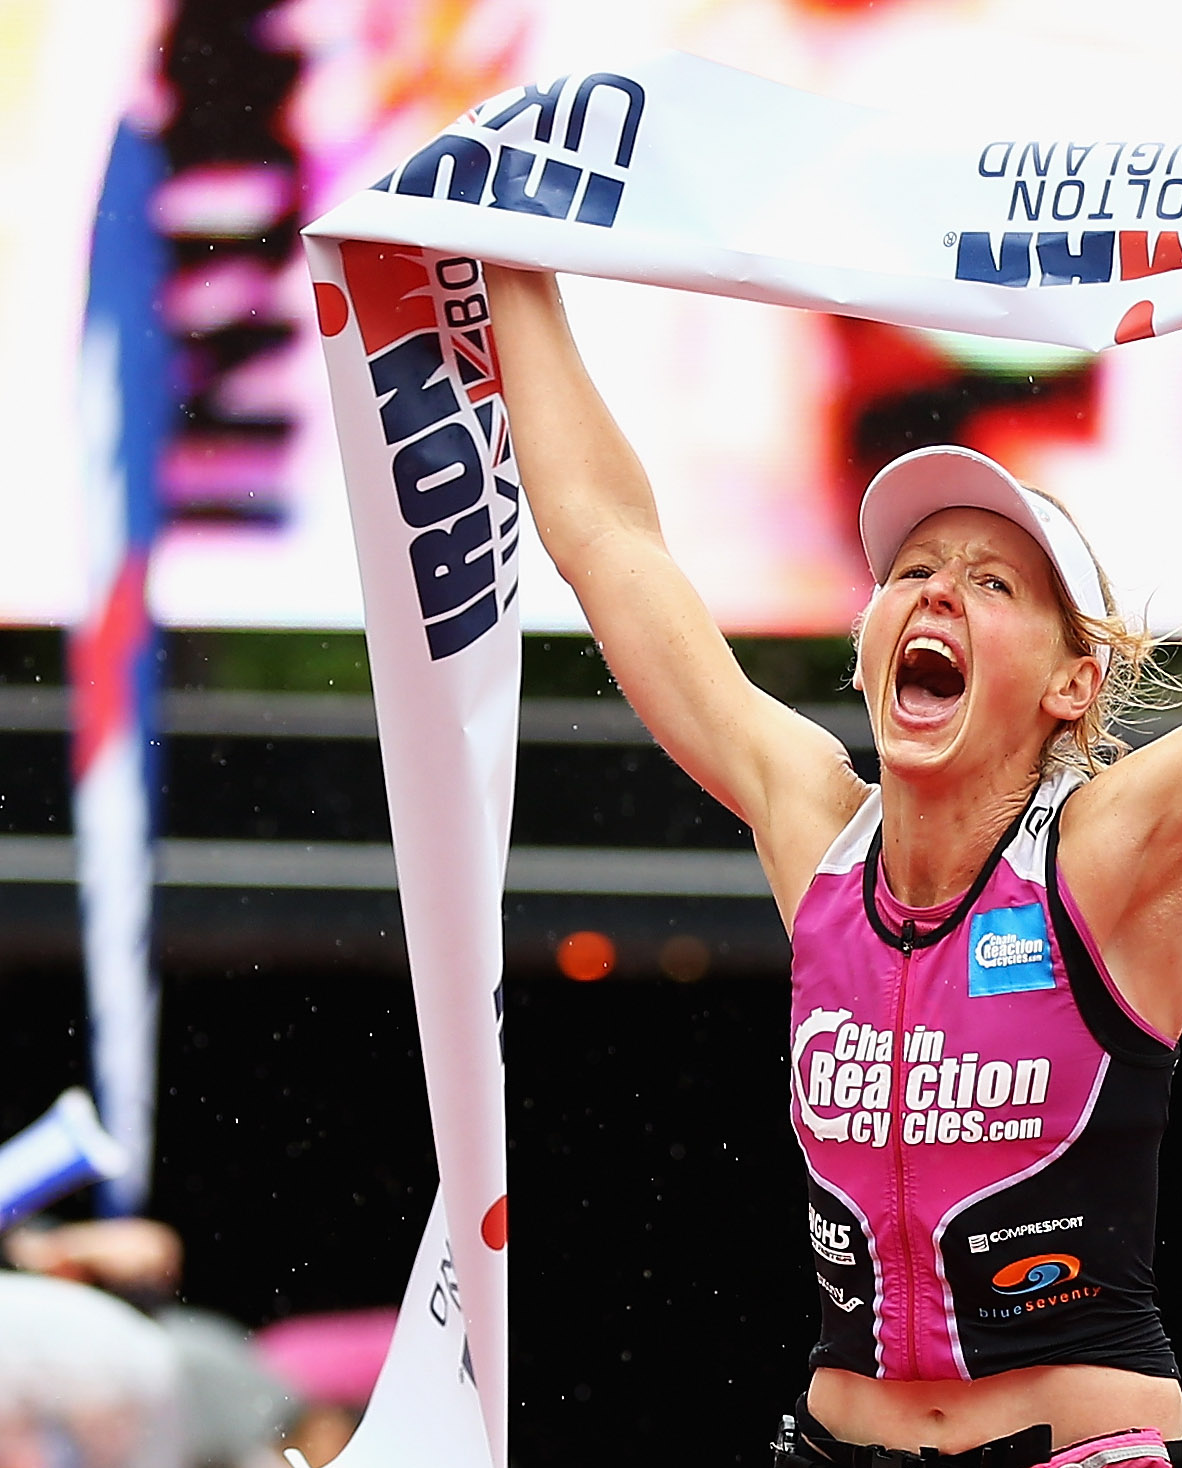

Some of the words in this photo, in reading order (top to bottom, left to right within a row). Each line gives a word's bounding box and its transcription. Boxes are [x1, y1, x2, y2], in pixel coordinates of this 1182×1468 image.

[983, 938, 1043, 960] Reaction
[834, 1021, 945, 1064] Chain
[807, 1050, 1051, 1112] Reaction
